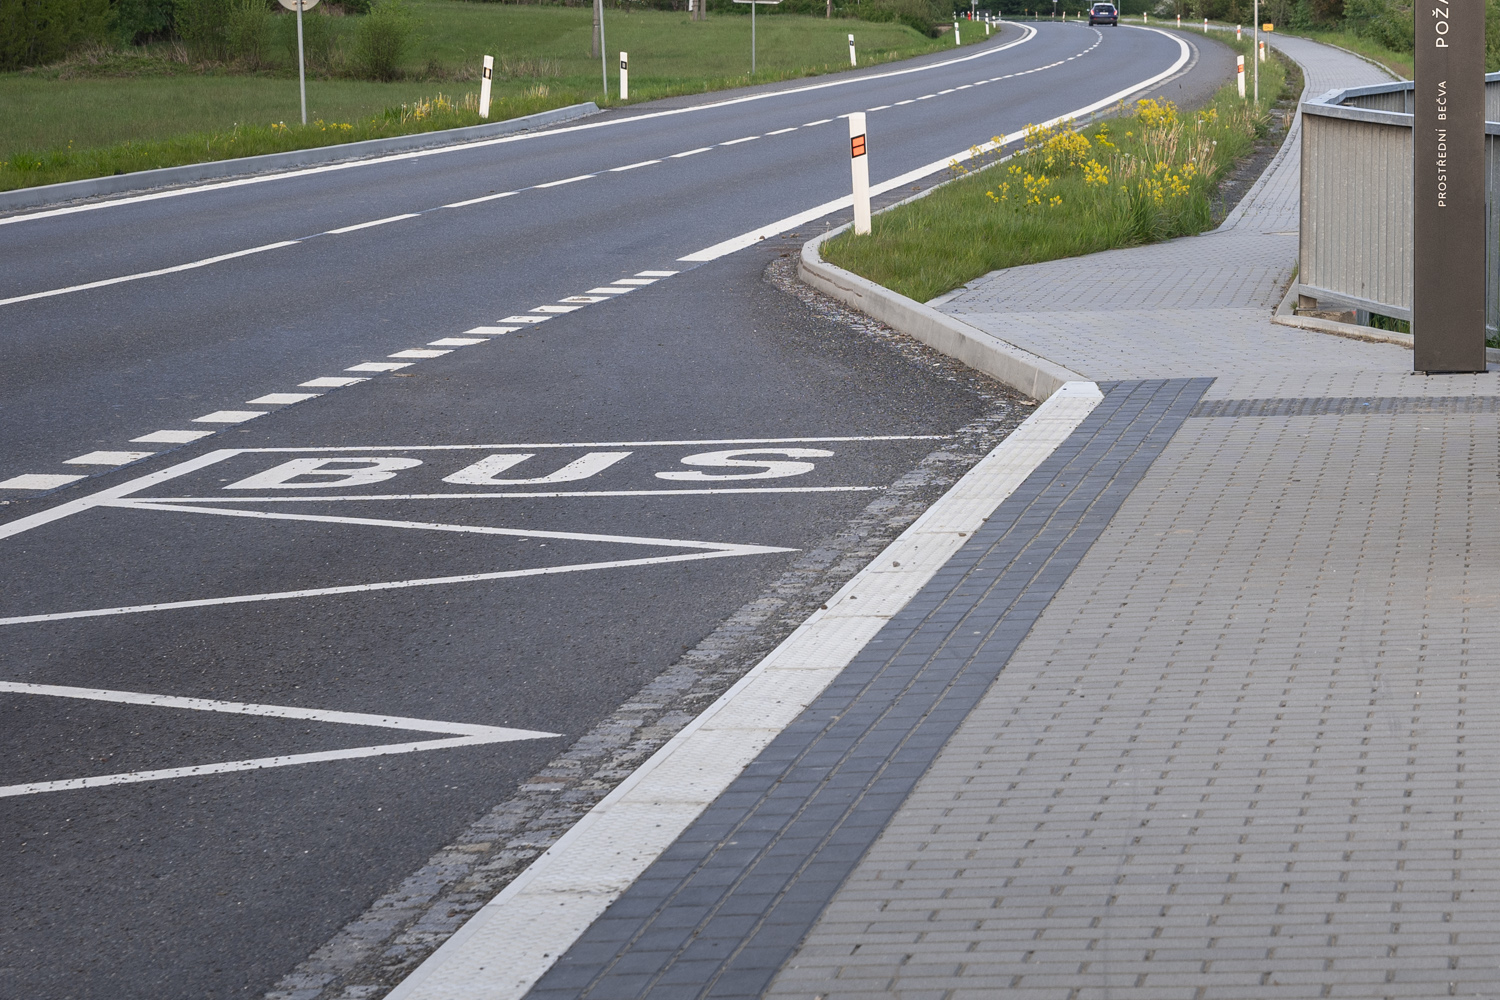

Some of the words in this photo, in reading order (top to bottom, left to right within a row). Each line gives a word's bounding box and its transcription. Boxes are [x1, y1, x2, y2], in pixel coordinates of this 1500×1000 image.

[1435, 80, 1447, 120] BEČVA
[1435, 128, 1447, 207] PROSTŘEDNÍ
[222, 448, 835, 490] BUS
